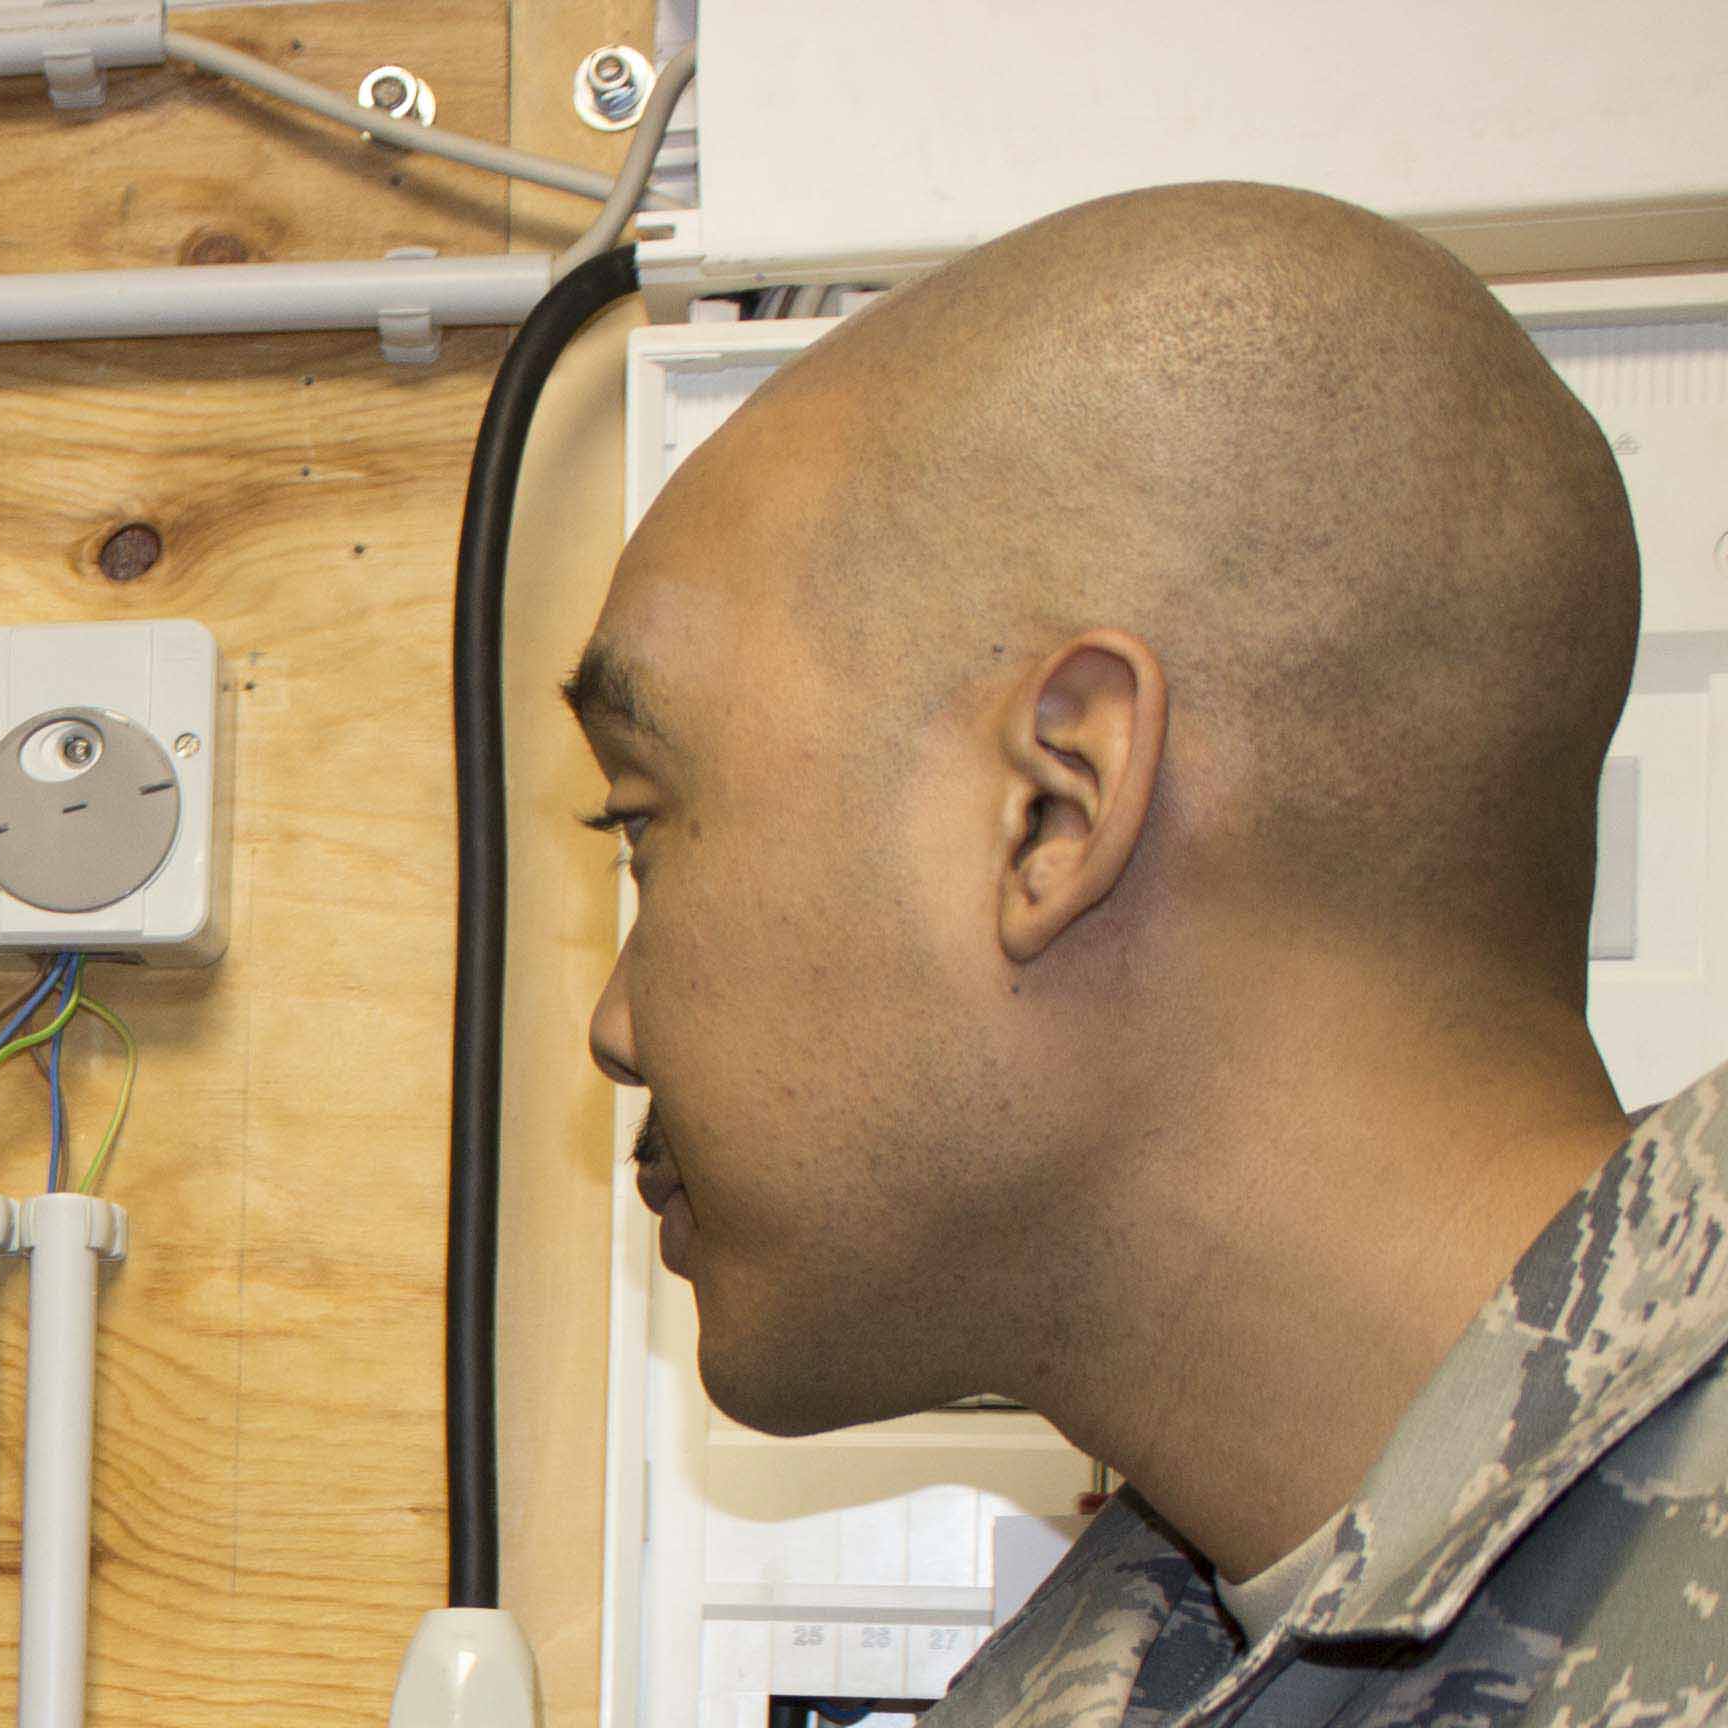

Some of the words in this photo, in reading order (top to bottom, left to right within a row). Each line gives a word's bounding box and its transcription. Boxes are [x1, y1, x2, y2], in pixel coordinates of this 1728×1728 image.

[793, 1624, 825, 1647] 25
[861, 1627, 892, 1649] 26
[928, 1629, 960, 1650] 27
